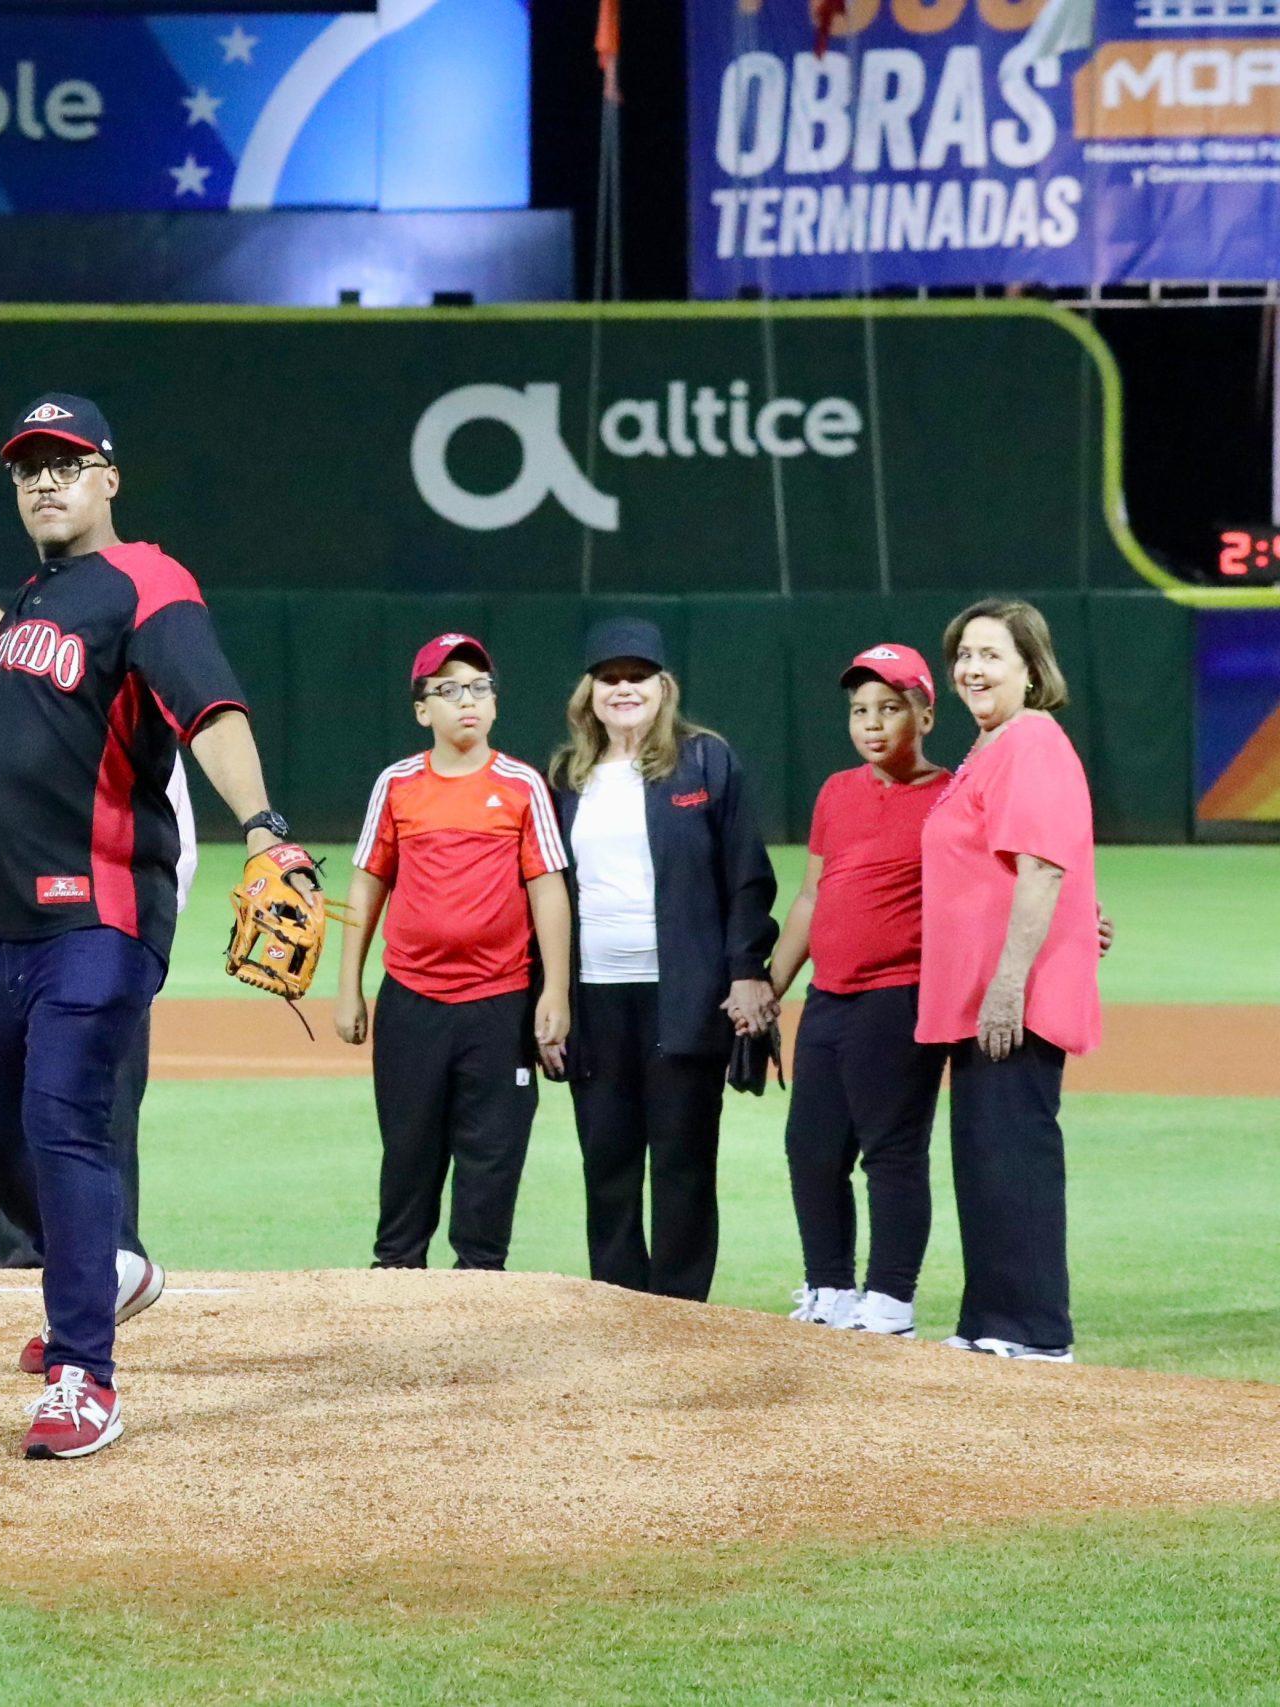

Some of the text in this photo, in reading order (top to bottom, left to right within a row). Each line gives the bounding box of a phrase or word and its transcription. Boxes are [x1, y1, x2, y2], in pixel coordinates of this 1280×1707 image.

[715, 45, 1062, 178] OBRAS
[711, 175, 1081, 259] TERMINADAS
[600, 380, 862, 457] altice
